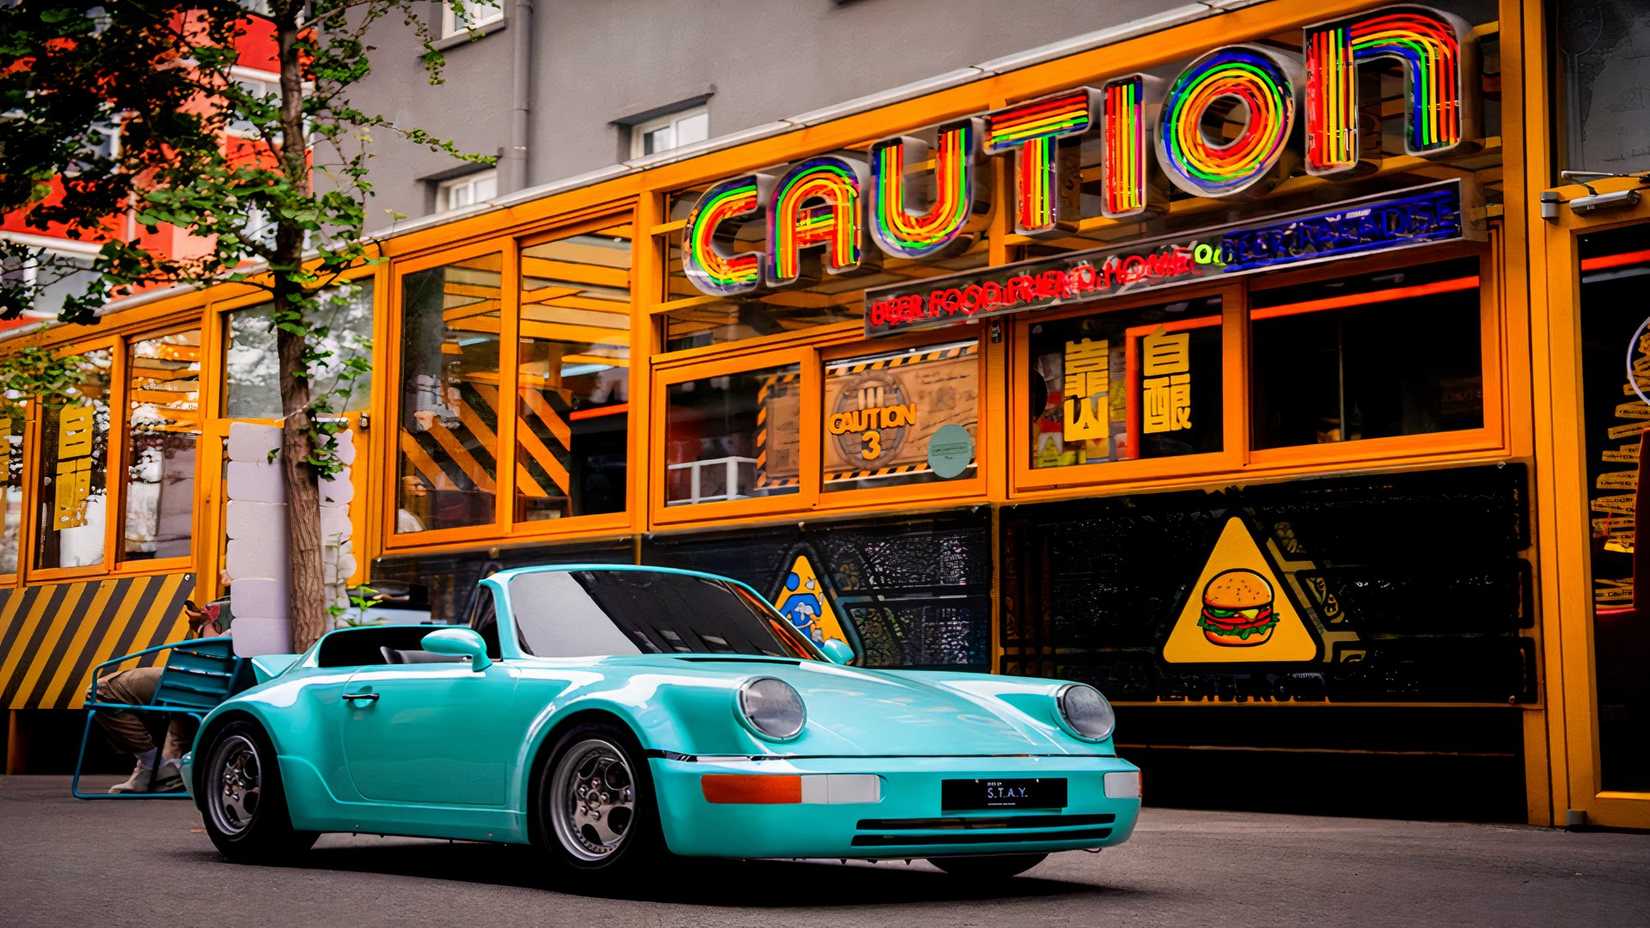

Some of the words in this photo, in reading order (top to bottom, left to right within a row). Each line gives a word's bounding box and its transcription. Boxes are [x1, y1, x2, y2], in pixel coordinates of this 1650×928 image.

[682, 5, 1466, 296] CAUTION
[928, 281, 1001, 318] FOOD
[829, 402, 917, 435] CAUTION
[861, 430, 882, 461] 3
